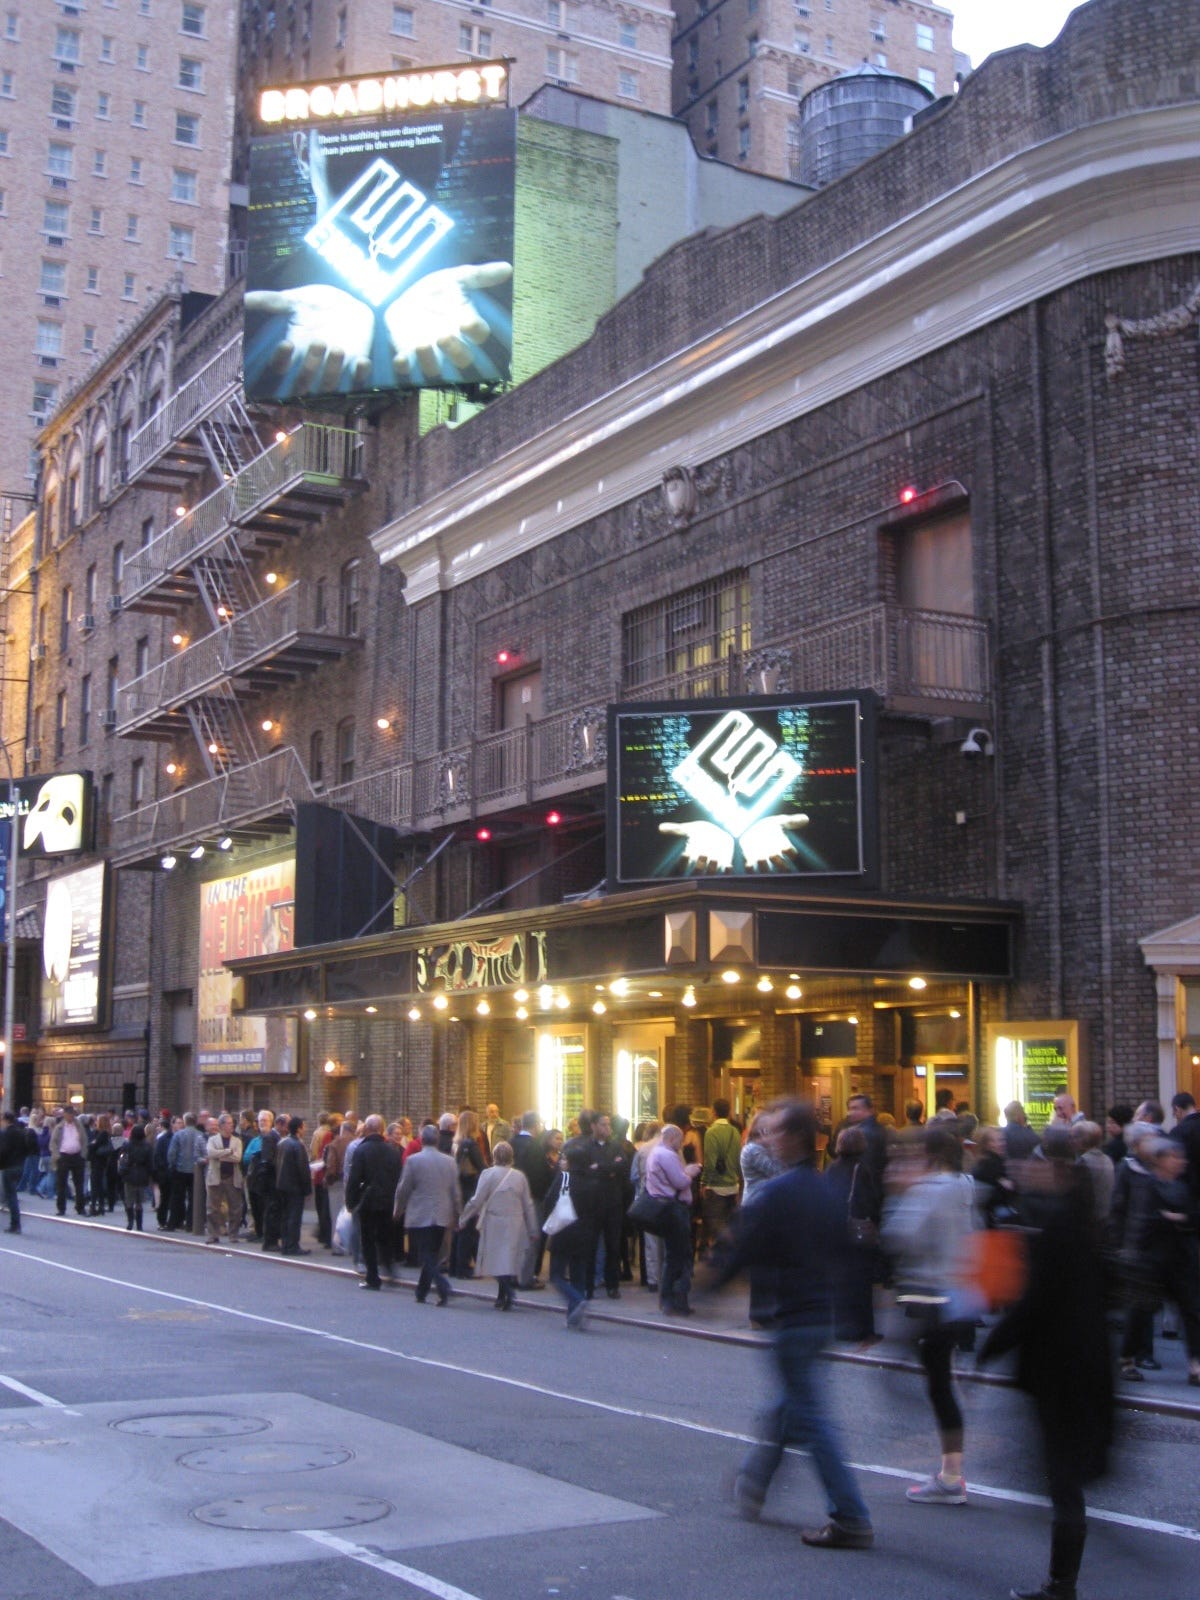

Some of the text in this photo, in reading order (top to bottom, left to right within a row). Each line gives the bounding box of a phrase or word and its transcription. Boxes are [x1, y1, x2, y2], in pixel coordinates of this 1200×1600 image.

[260, 65, 506, 122] BROADHURST
[340, 133, 348, 141] is
[348, 131, 380, 140] nothing
[380, 128, 402, 138] more
[402, 124, 443, 135] dangerous
[339, 144, 364, 156] power
[364, 142, 374, 151] in
[374, 140, 389, 150] the
[389, 139, 414, 148] wrong
[207, 876, 247, 905] IN THE
